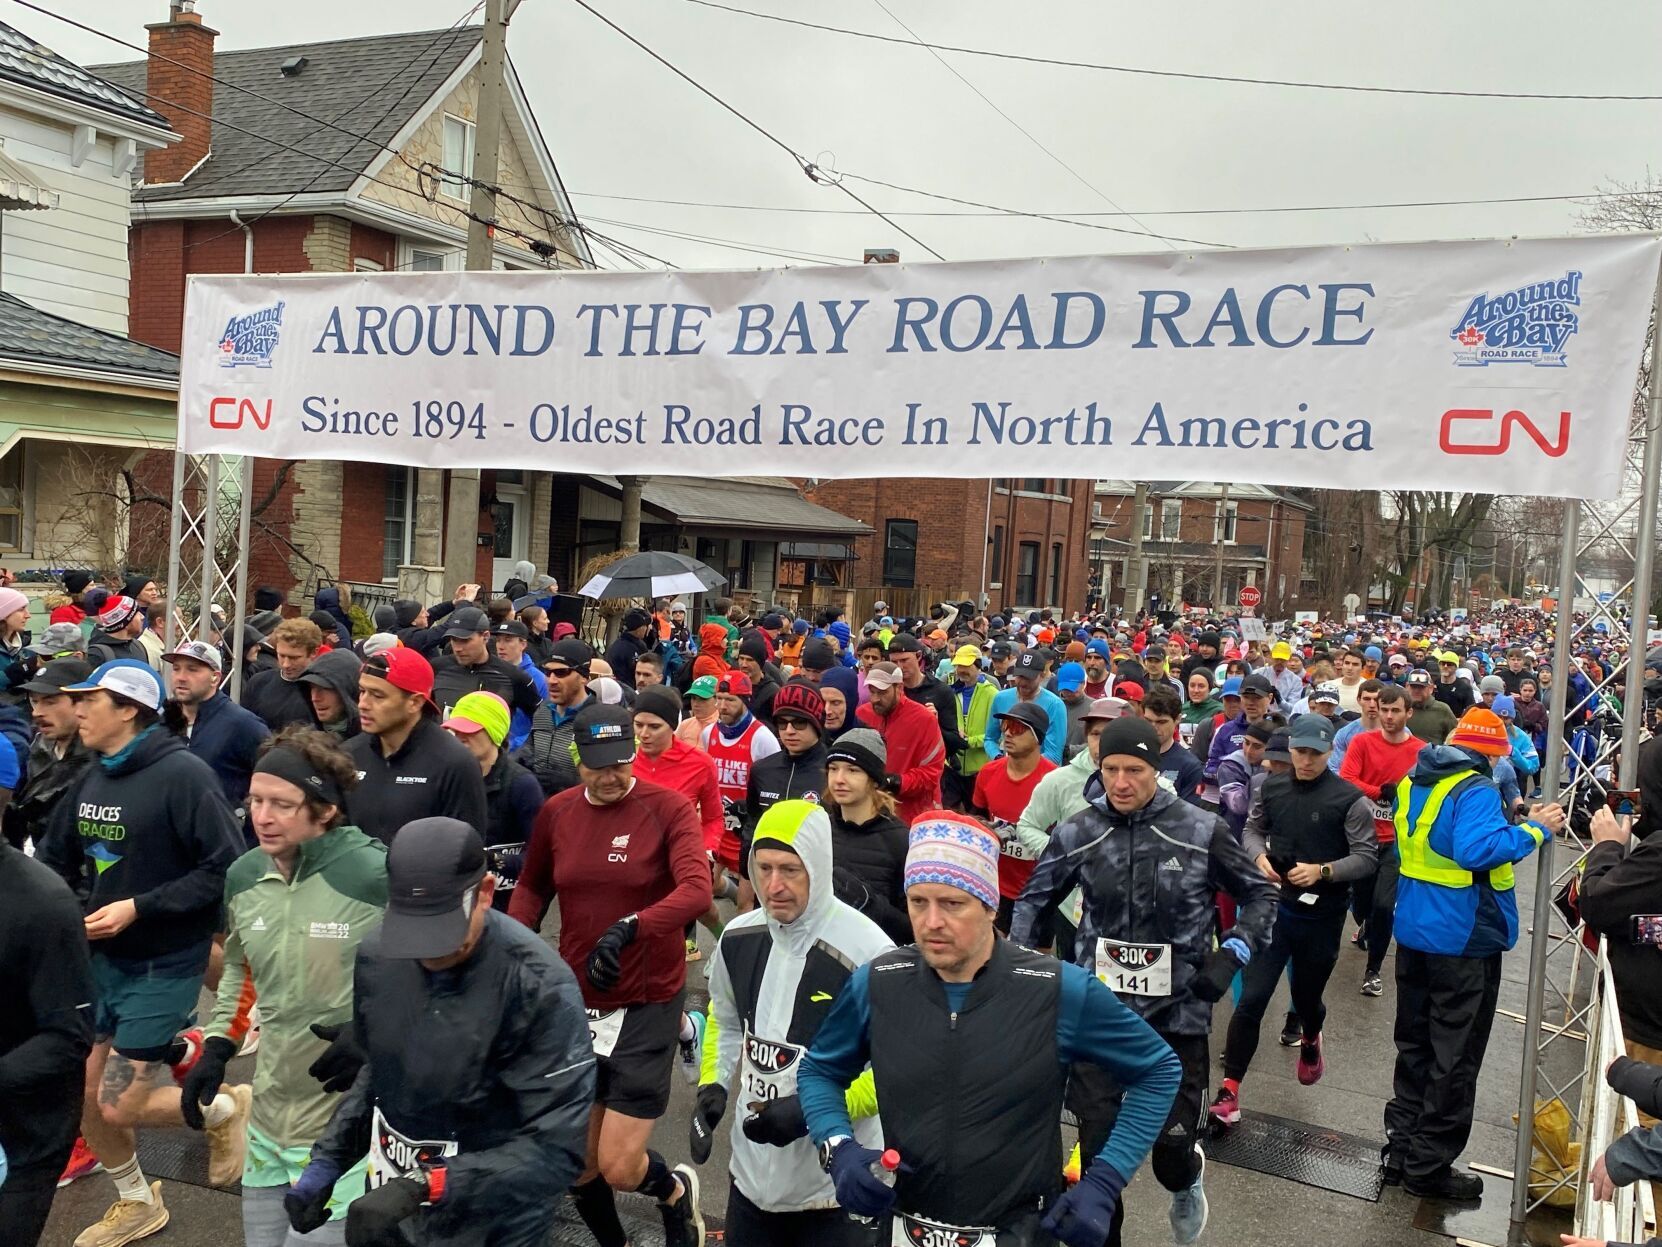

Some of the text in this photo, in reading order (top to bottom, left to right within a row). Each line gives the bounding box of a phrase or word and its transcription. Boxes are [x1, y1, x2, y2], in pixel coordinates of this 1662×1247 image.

[1450, 270, 1582, 338] Around
[1528, 302, 1574, 322] the
[219, 301, 285, 343] Around
[312, 283, 1376, 357] AROUND THE BAY ROAD RACE
[234, 330, 278, 358] Bay
[1484, 312, 1577, 354] Bay
[1480, 350, 1538, 358] ROAD RACE
[209, 396, 272, 431] CN
[301, 396, 399, 437] Since
[412, 400, 487, 440] 1894
[529, 403, 647, 444] Oldest
[661, 403, 762, 446] Road
[778, 403, 885, 446] Race
[901, 402, 949, 446] In
[966, 401, 1113, 446] North
[1130, 401, 1375, 451] America
[1439, 409, 1571, 457] CN
[1240, 592, 1259, 601] STOP
[725, 759, 748, 771] LIKE
[79, 802, 121, 822] DEUCES
[607, 853, 628, 863] CN
[337, 923, 350, 931] 20
[337, 931, 350, 939] 22
[1119, 946, 1149, 966] 30K
[1116, 973, 1149, 993] 141
[749, 1040, 781, 1071] 30K
[748, 1073, 779, 1101] 130
[386, 1134, 420, 1170] 30K
[921, 1226, 960, 1247] 30K
